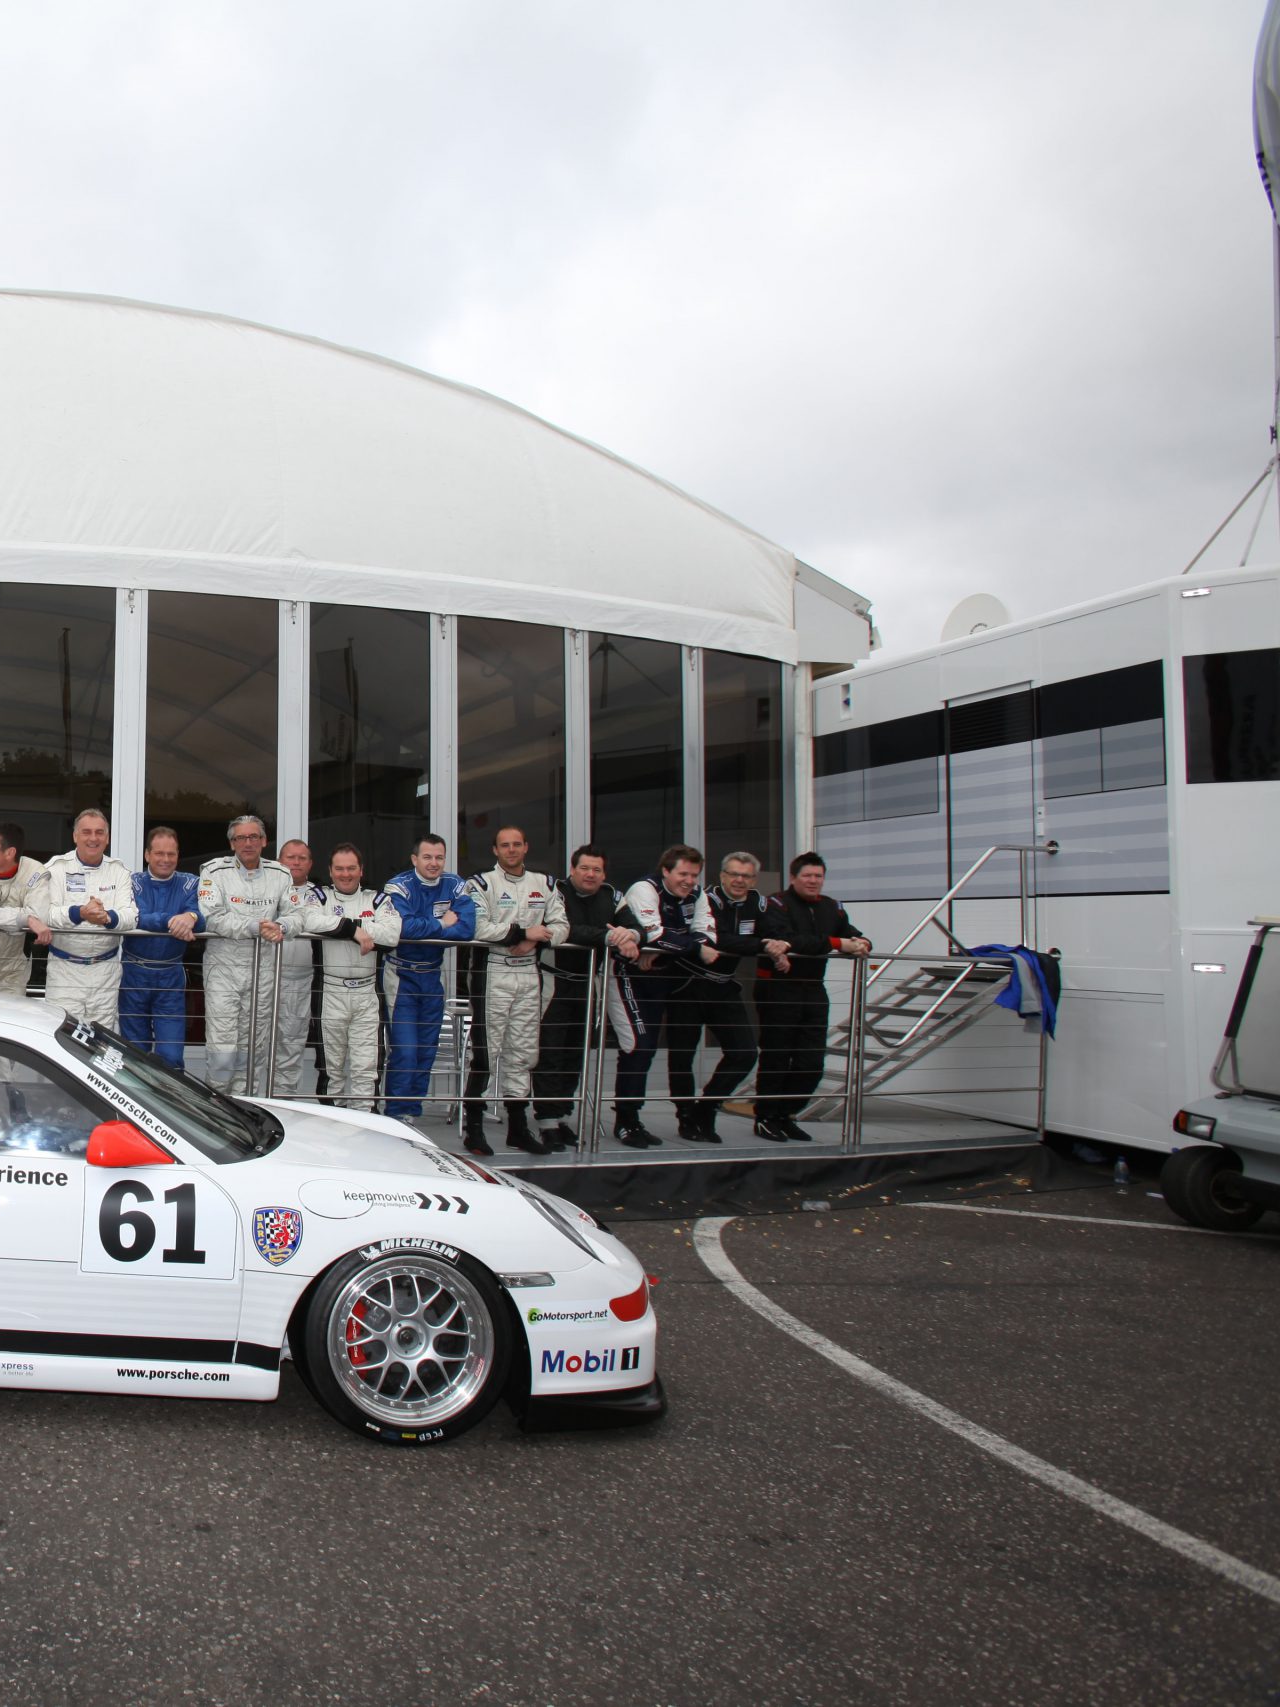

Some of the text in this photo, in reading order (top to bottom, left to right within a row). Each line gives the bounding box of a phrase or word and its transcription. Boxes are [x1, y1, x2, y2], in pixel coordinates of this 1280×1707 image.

[86, 1072, 178, 1146] www.porsche.com
[343, 1190, 417, 1205] keepmoving
[98, 1179, 206, 1264] 61
[380, 1237, 459, 1259] MICHELIN
[529, 1309, 608, 1322] GoMotorsport.net
[540, 1348, 616, 1373] Mobil
[117, 1367, 230, 1382] www.porsche.com
